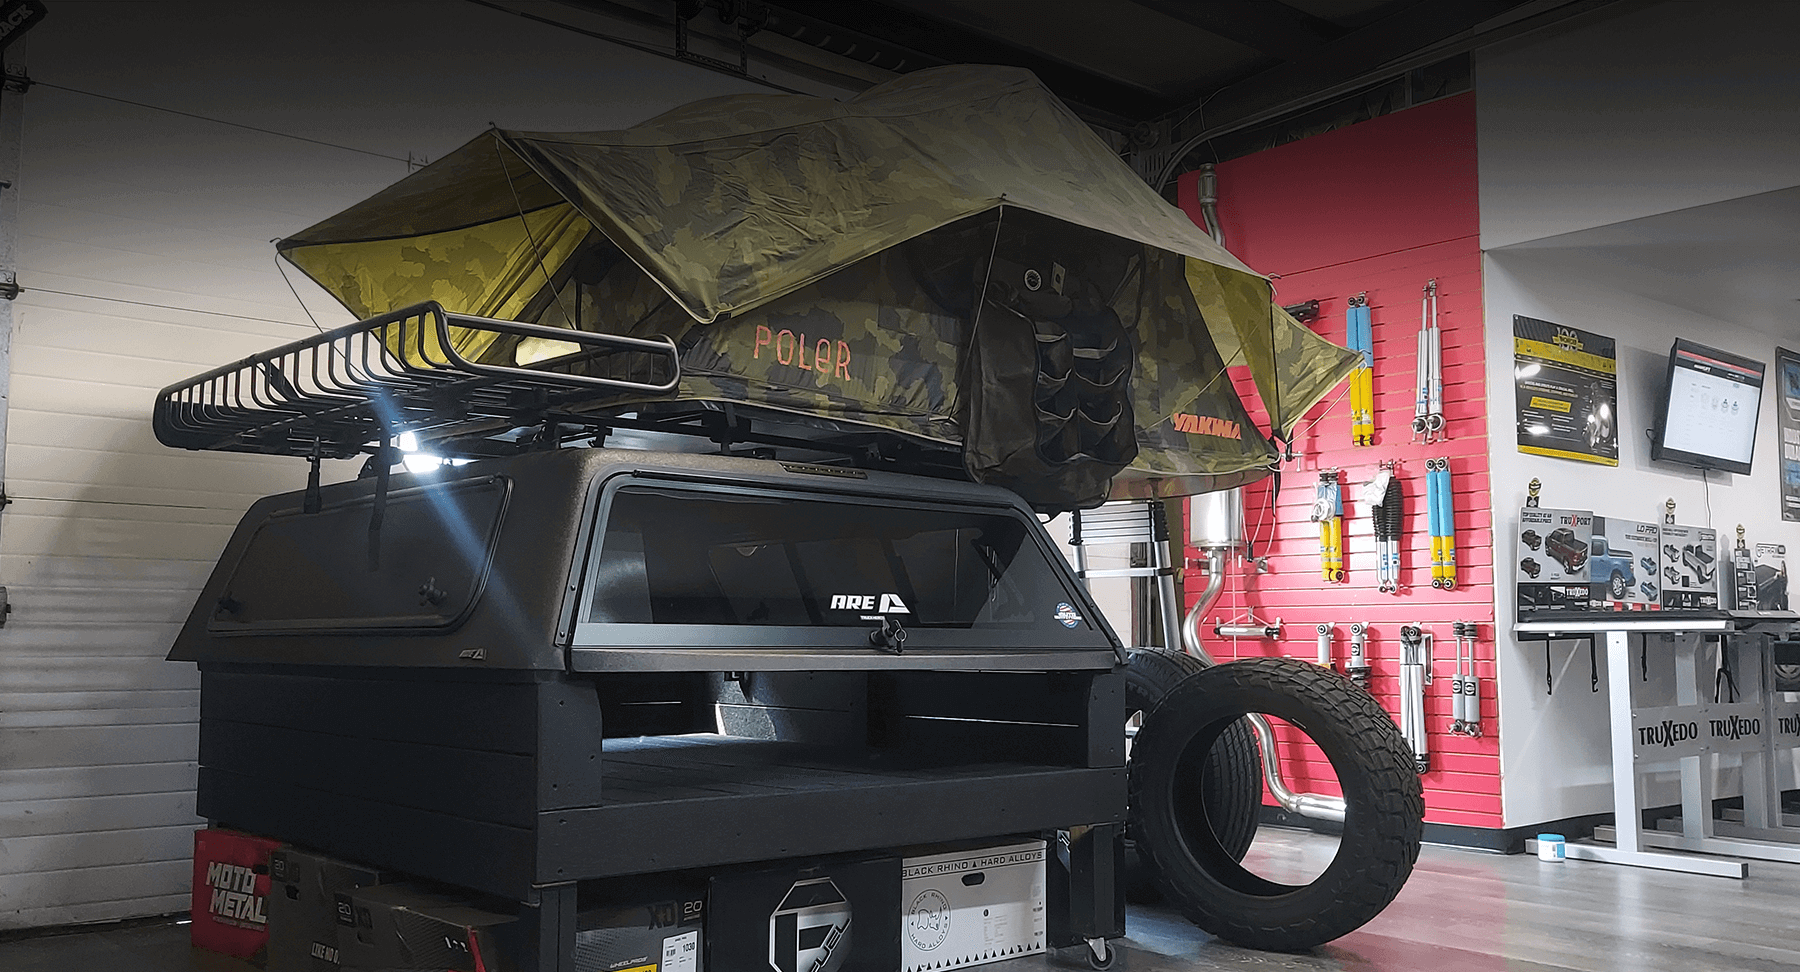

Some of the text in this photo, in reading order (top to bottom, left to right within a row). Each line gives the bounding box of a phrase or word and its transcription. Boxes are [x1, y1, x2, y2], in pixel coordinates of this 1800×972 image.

[0, 4, 34, 41] ACK
[1173, 412, 1241, 440] YAKIMA
[1560, 514, 1591, 527] TRUXPORT
[830, 594, 876, 610] ARE
[1638, 720, 1698, 747] TRUXEDO
[1709, 715, 1761, 740] TRUXEDO
[937, 861, 968, 873] RHINO
[980, 856, 1006, 867] HARD
[1008, 851, 1043, 863] ALLOYS
[205, 861, 258, 894] MOTO
[208, 888, 267, 923] METAL
[684, 900, 703, 914] 20
[911, 892, 947, 915] BLACK RHINO
[911, 923, 948, 949] HARD ALLOYS
